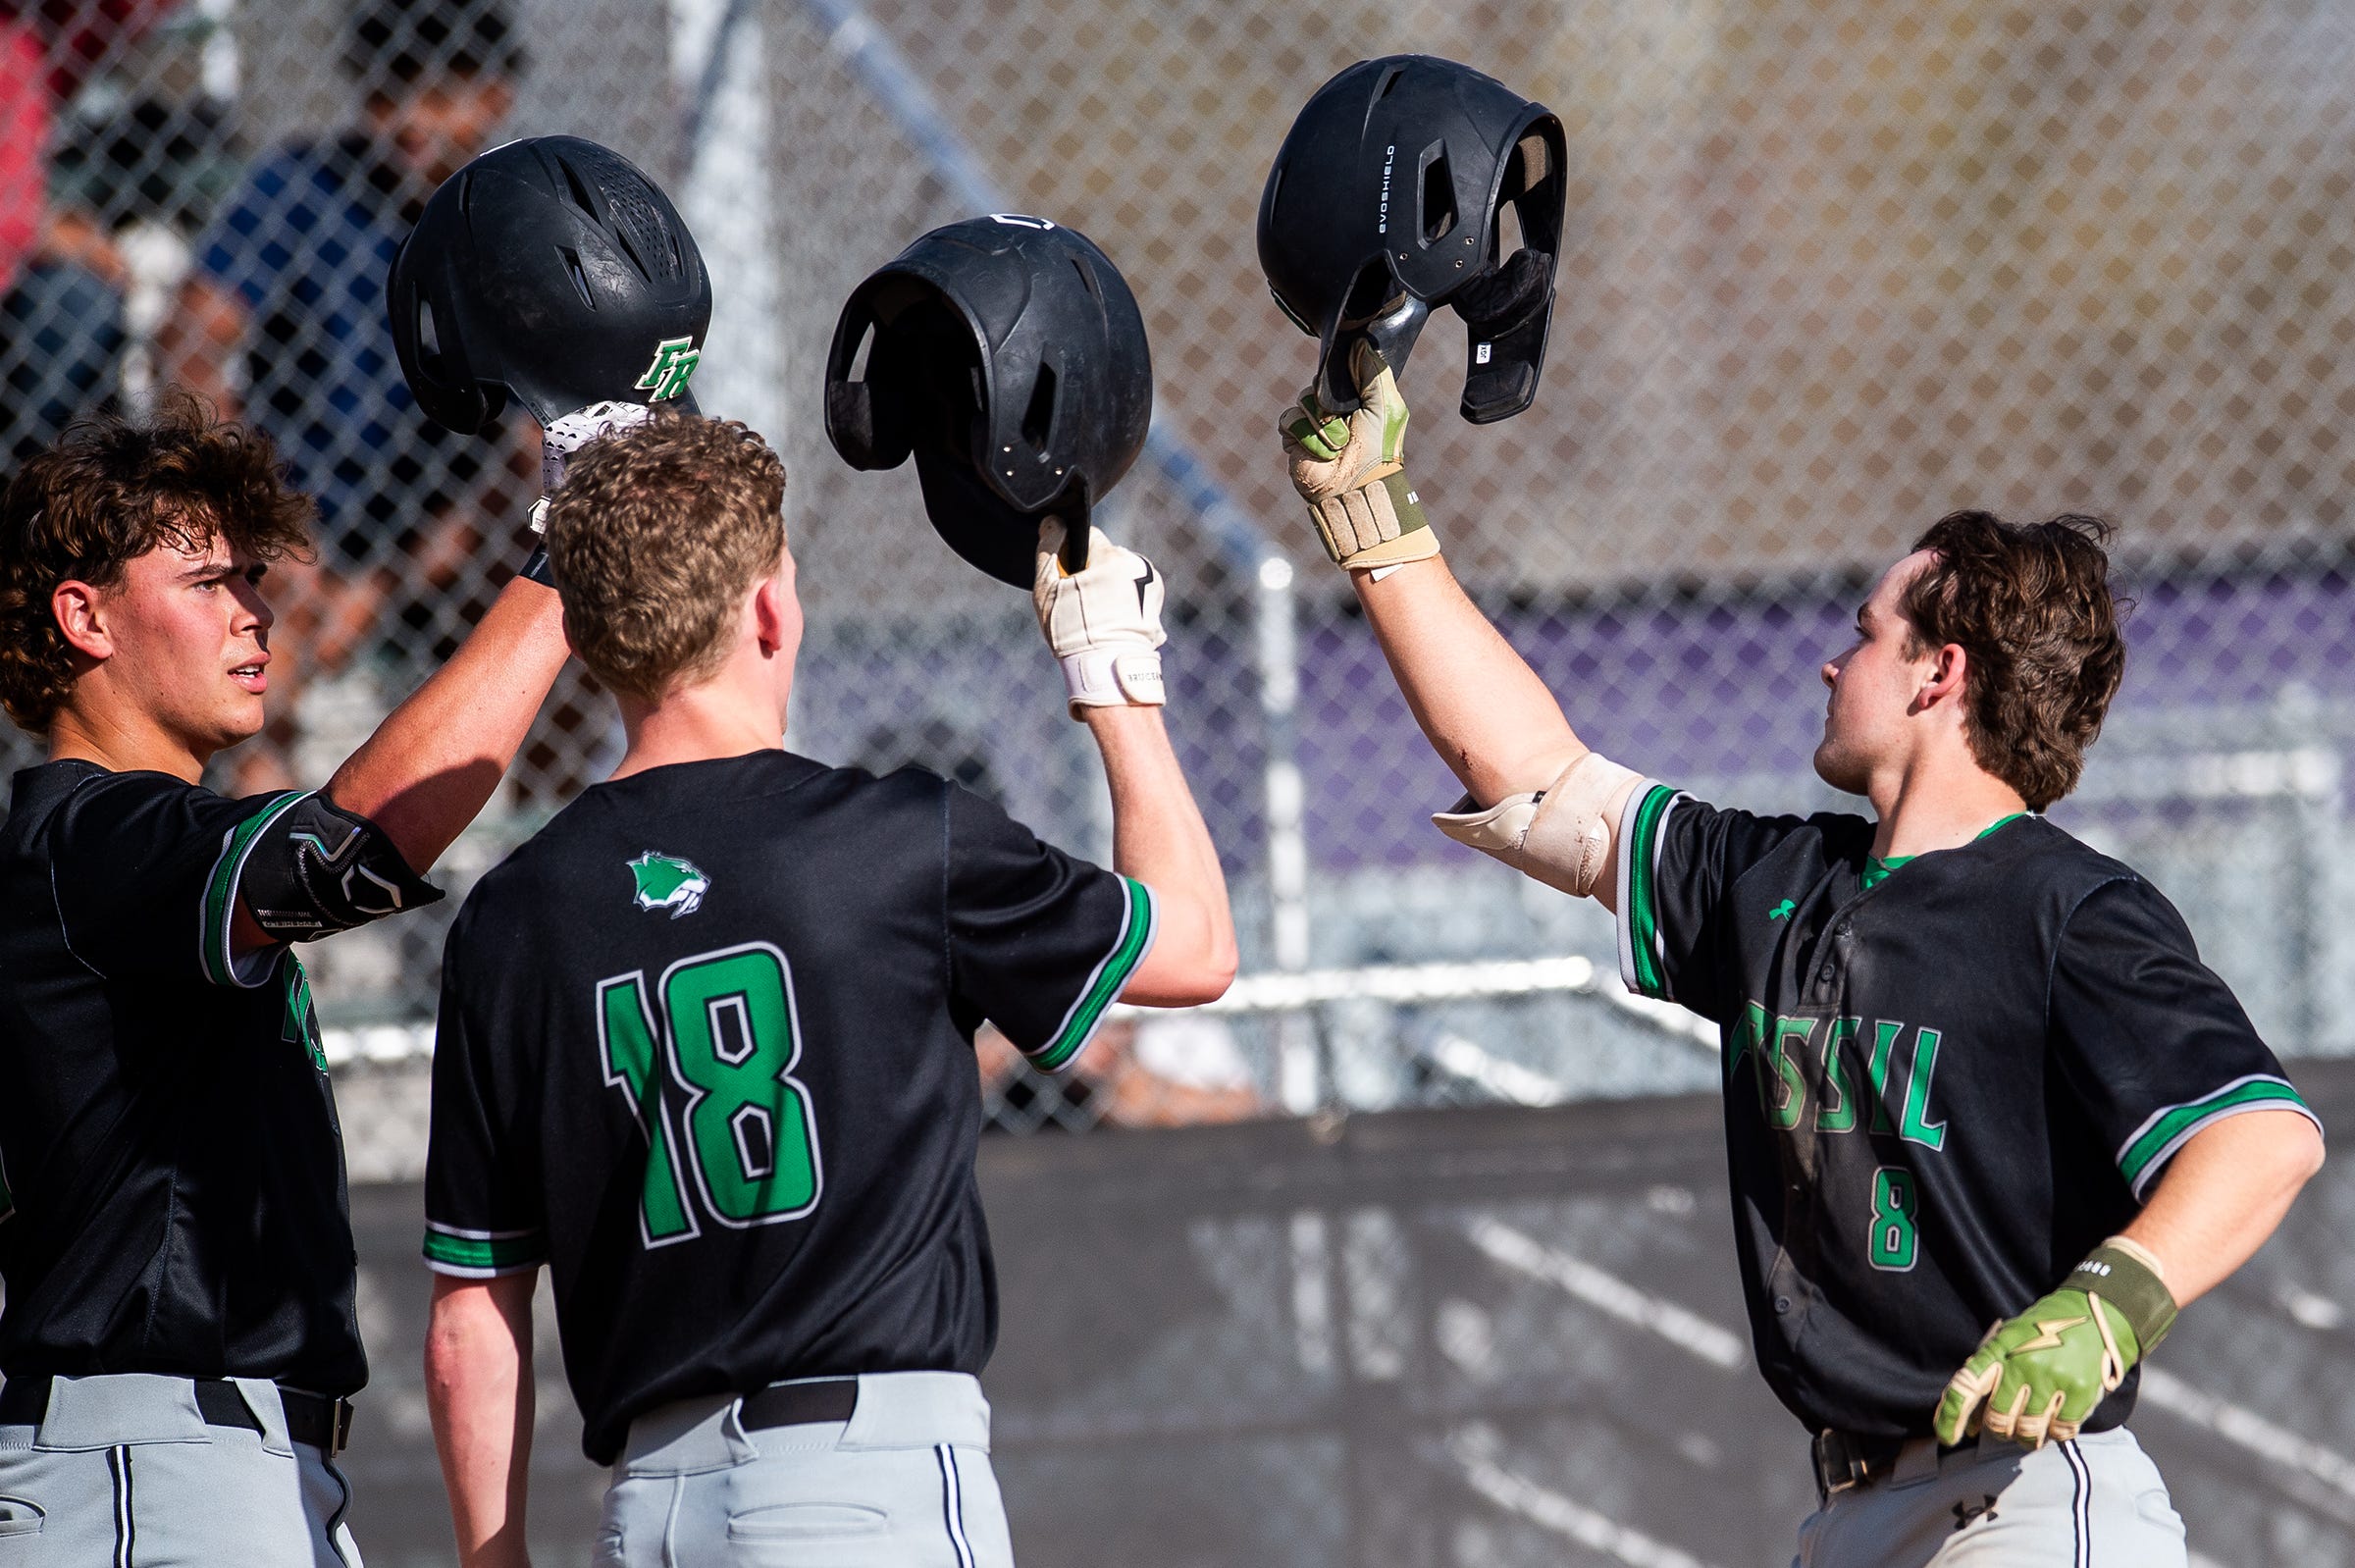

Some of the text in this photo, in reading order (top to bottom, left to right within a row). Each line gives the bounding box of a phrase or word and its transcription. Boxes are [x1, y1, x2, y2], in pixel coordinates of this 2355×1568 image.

[634, 335, 701, 403] FR
[596, 940, 823, 1251] 18
[1729, 998, 1948, 1153] SSIL
[1868, 1167, 1919, 1272] 8
